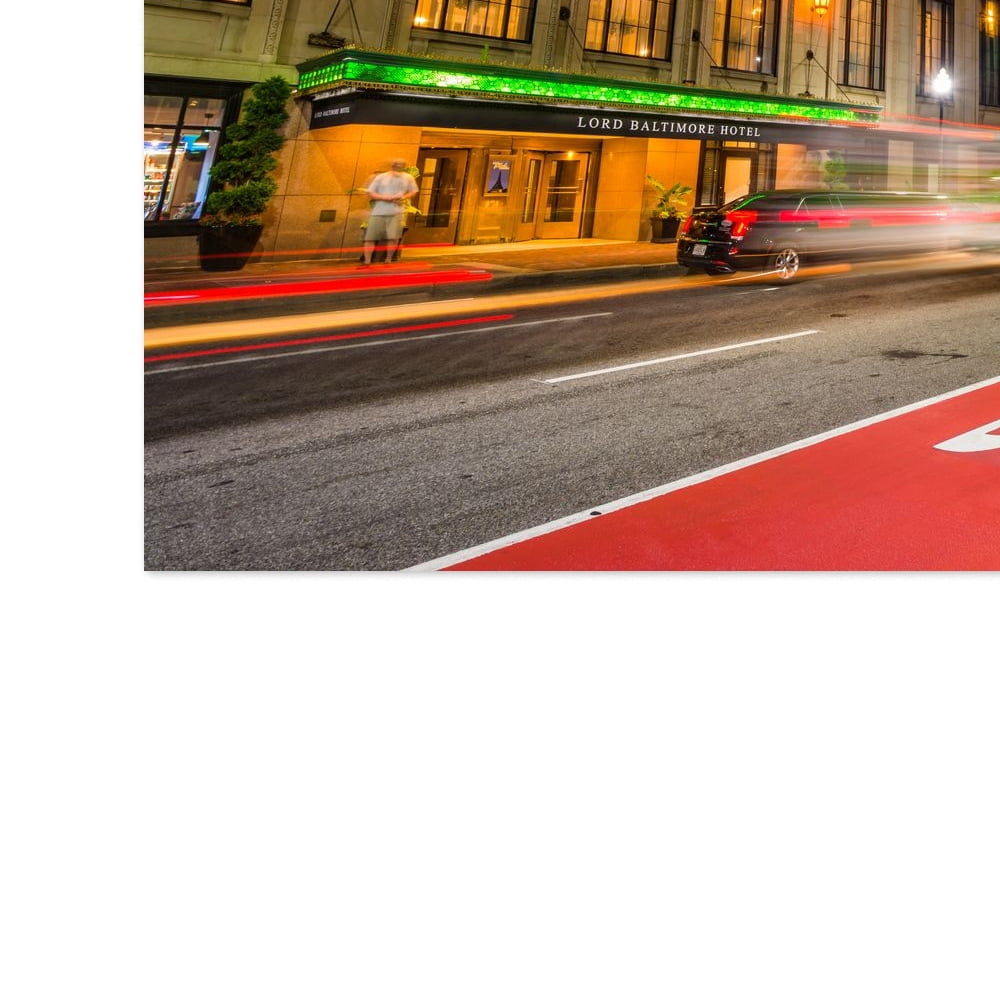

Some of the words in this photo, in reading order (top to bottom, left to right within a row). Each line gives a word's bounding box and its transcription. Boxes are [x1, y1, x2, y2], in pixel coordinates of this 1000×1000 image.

[577, 116, 623, 130] LORD
[630, 119, 715, 135] BALTIMORE
[720, 125, 761, 137] HOTEL
